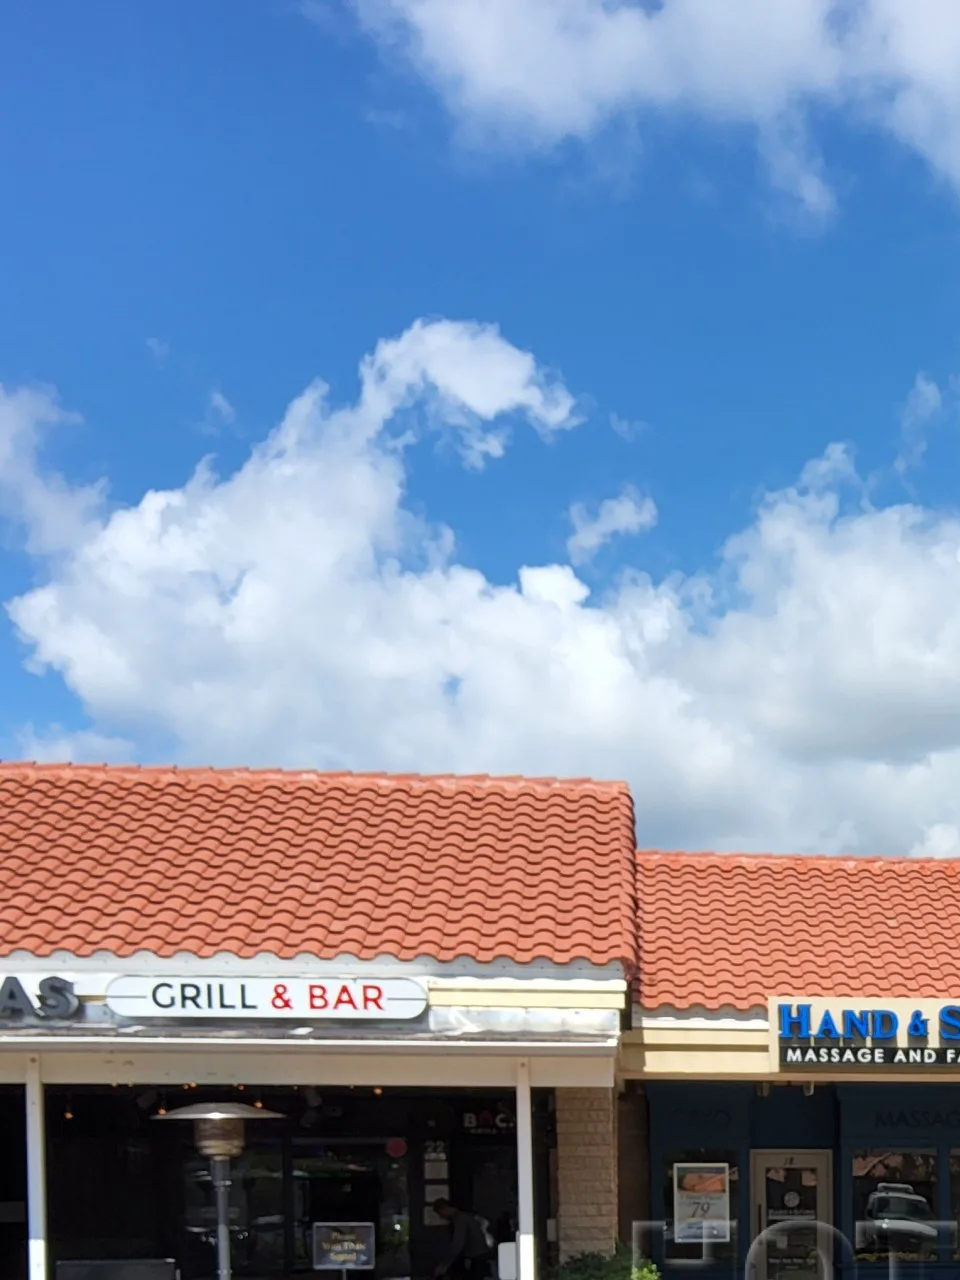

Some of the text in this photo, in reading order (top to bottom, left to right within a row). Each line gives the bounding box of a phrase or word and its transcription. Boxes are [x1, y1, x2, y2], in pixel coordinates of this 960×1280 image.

[151, 982, 386, 1011] GRILL & BAR
[779, 1003, 899, 1039] HAND
[907, 1009, 930, 1038] &
[786, 1047, 885, 1064] MASSAGE
[893, 1048, 938, 1064] AND
